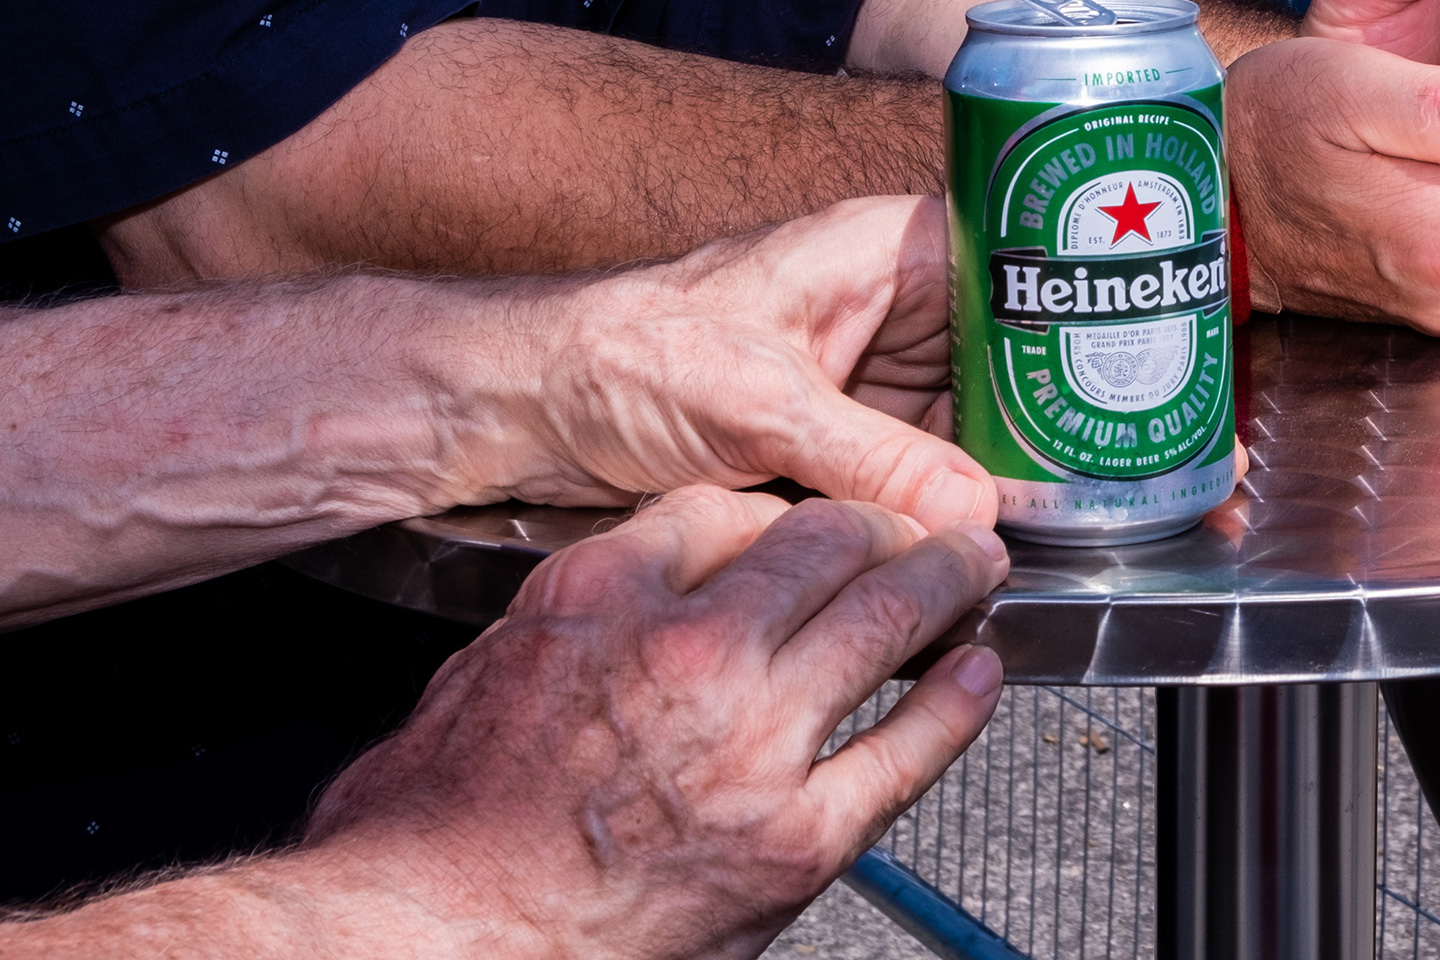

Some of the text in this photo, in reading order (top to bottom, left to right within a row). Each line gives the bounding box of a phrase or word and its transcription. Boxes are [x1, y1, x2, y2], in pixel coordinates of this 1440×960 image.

[1084, 68, 1161, 86] IMPORTED
[1084, 114, 1169, 131] ORIGINAL RECIPE
[1019, 133, 1217, 229] BREWED IN HOLLAND
[1071, 213, 1081, 250] DIPLOME
[1078, 181, 1123, 210] D'HONNEUR
[1138, 180, 1178, 204] AMSTERDAM
[1175, 205, 1184, 216] EN
[1088, 230, 1172, 245] EST. 1873
[1003, 257, 1226, 314] Heineken
[1086, 331, 1120, 340] MEDAILLE
[1122, 329, 1139, 337] D'OR
[1142, 326, 1161, 336] PARIS
[1022, 345, 1047, 355] TRADE
[1073, 333, 1081, 355] HORS
[1091, 341, 1116, 349] GRAND
[1119, 339, 1135, 347] PRIX
[1138, 336, 1156, 345] PARIS
[1177, 346, 1188, 372] PARIS
[1075, 359, 1106, 398] CONCOURS
[1163, 375, 1179, 393] JURY
[1027, 352, 1218, 449] PREMIUM QUALITY
[1109, 393, 1145, 403] MEMBRE
[1148, 389, 1160, 399] DU
[1052, 427, 1207, 467] 12 FL. OZ. LAGER BEER 5% ALC./VOL.
[1030, 497, 1059, 509] ALL
[1074, 494, 1159, 509] NATURAL
